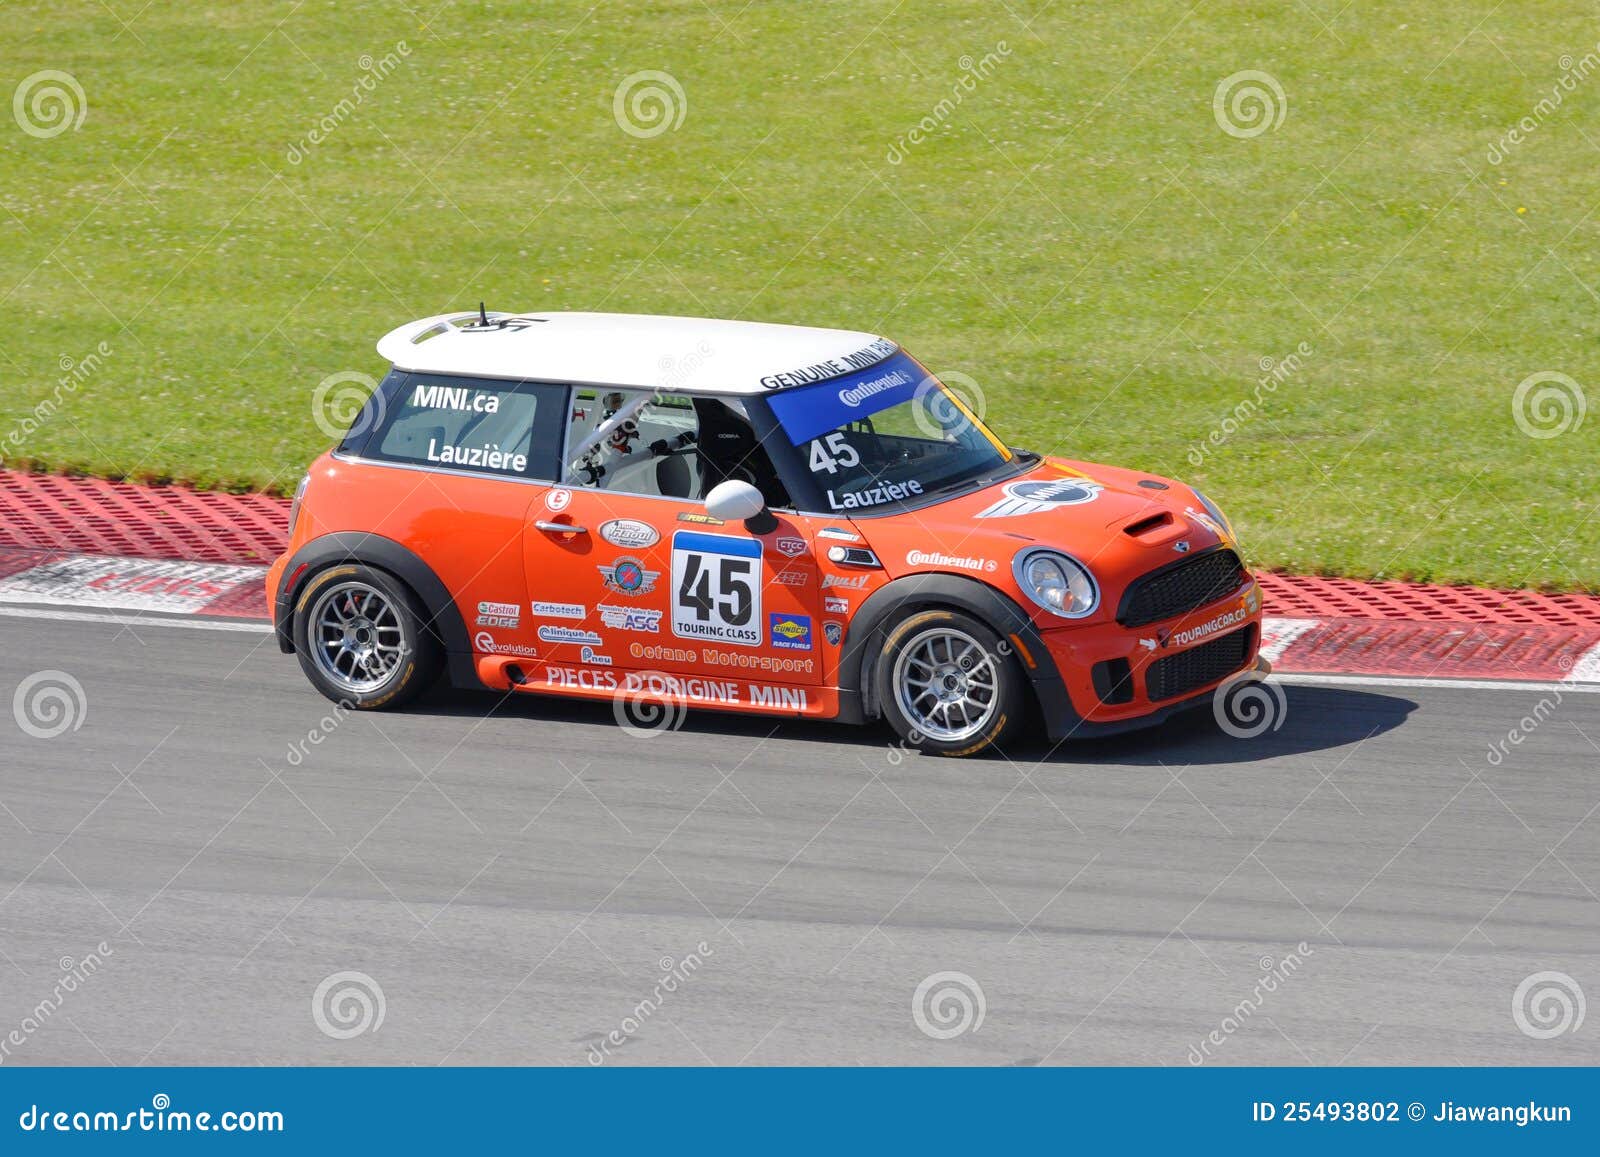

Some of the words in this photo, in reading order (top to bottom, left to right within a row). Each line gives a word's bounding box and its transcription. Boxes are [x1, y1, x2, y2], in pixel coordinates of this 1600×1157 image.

[760, 359, 845, 389] GENUINE
[838, 370, 908, 407] Continental
[413, 384, 500, 413] MINI.ca
[427, 438, 527, 471] Lauzière
[808, 432, 860, 474] 45
[826, 478, 924, 510] Lauzière
[906, 549, 984, 571] Continental
[679, 554, 752, 626] 45
[476, 615, 520, 629] EDGE
[488, 604, 517, 616] Castrol
[677, 622, 724, 637] TOURING
[726, 628, 757, 640] CLASS
[773, 624, 808, 635] SUNOCO
[630, 642, 697, 662] Octane
[703, 648, 814, 673] Motorsport
[546, 665, 618, 691] PIECES
[624, 672, 740, 704] D'ORIGINE
[749, 684, 807, 711] MINI
